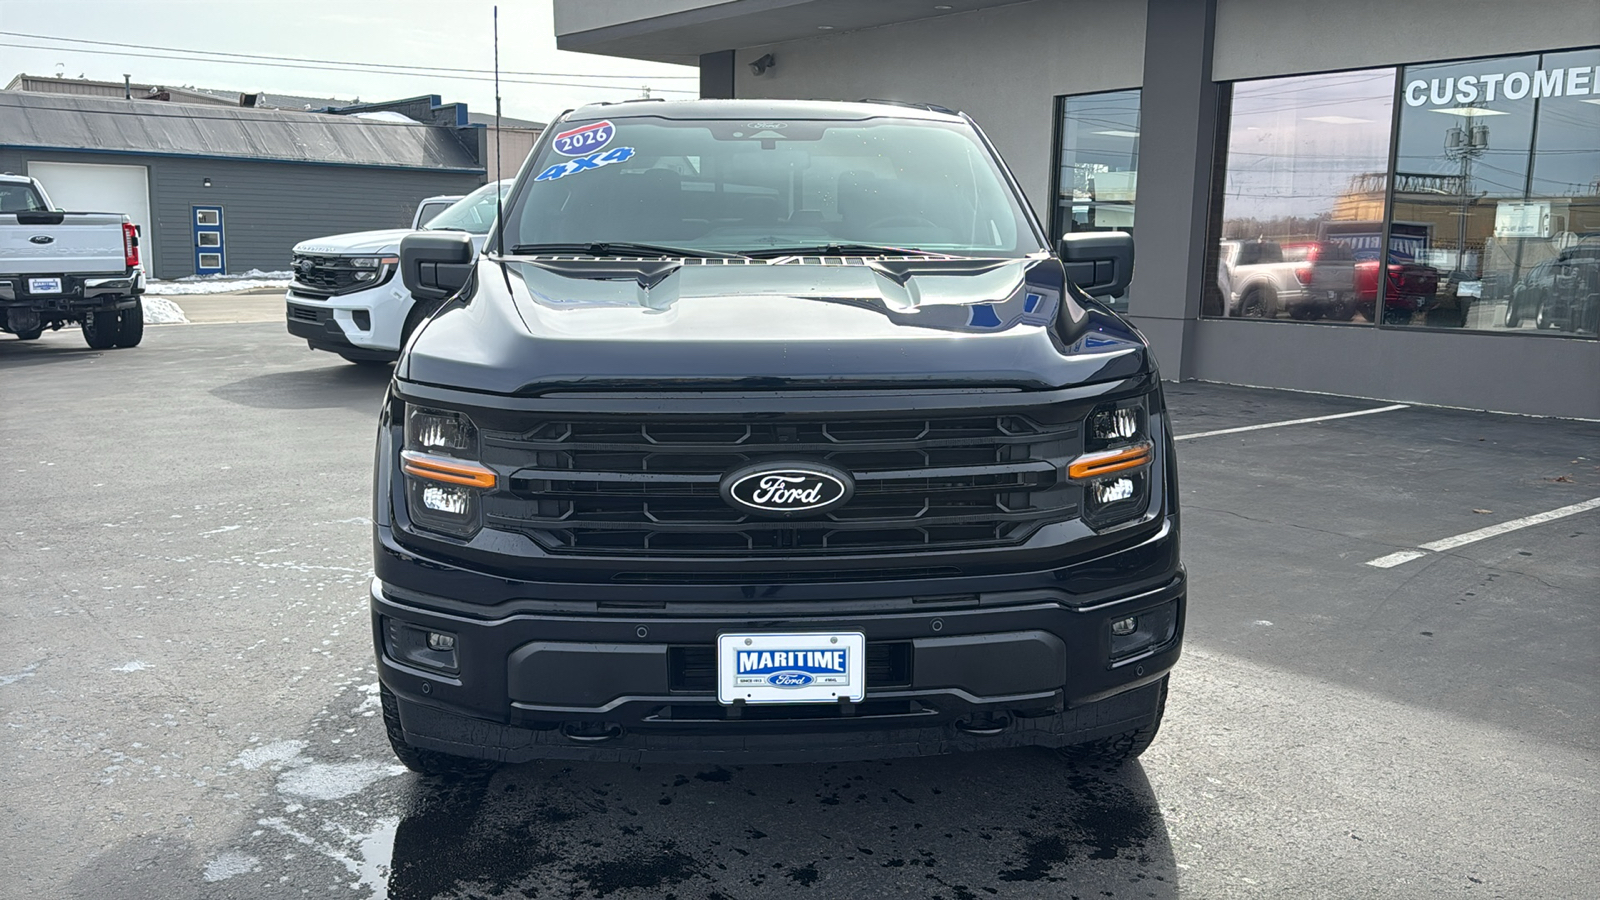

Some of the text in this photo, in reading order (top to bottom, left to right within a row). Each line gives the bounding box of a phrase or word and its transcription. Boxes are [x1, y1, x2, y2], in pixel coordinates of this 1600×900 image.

[561, 128, 607, 152] 2026
[753, 475, 823, 503] Ford
[739, 651, 844, 673] MARITIME
[775, 674, 805, 686] Ford
